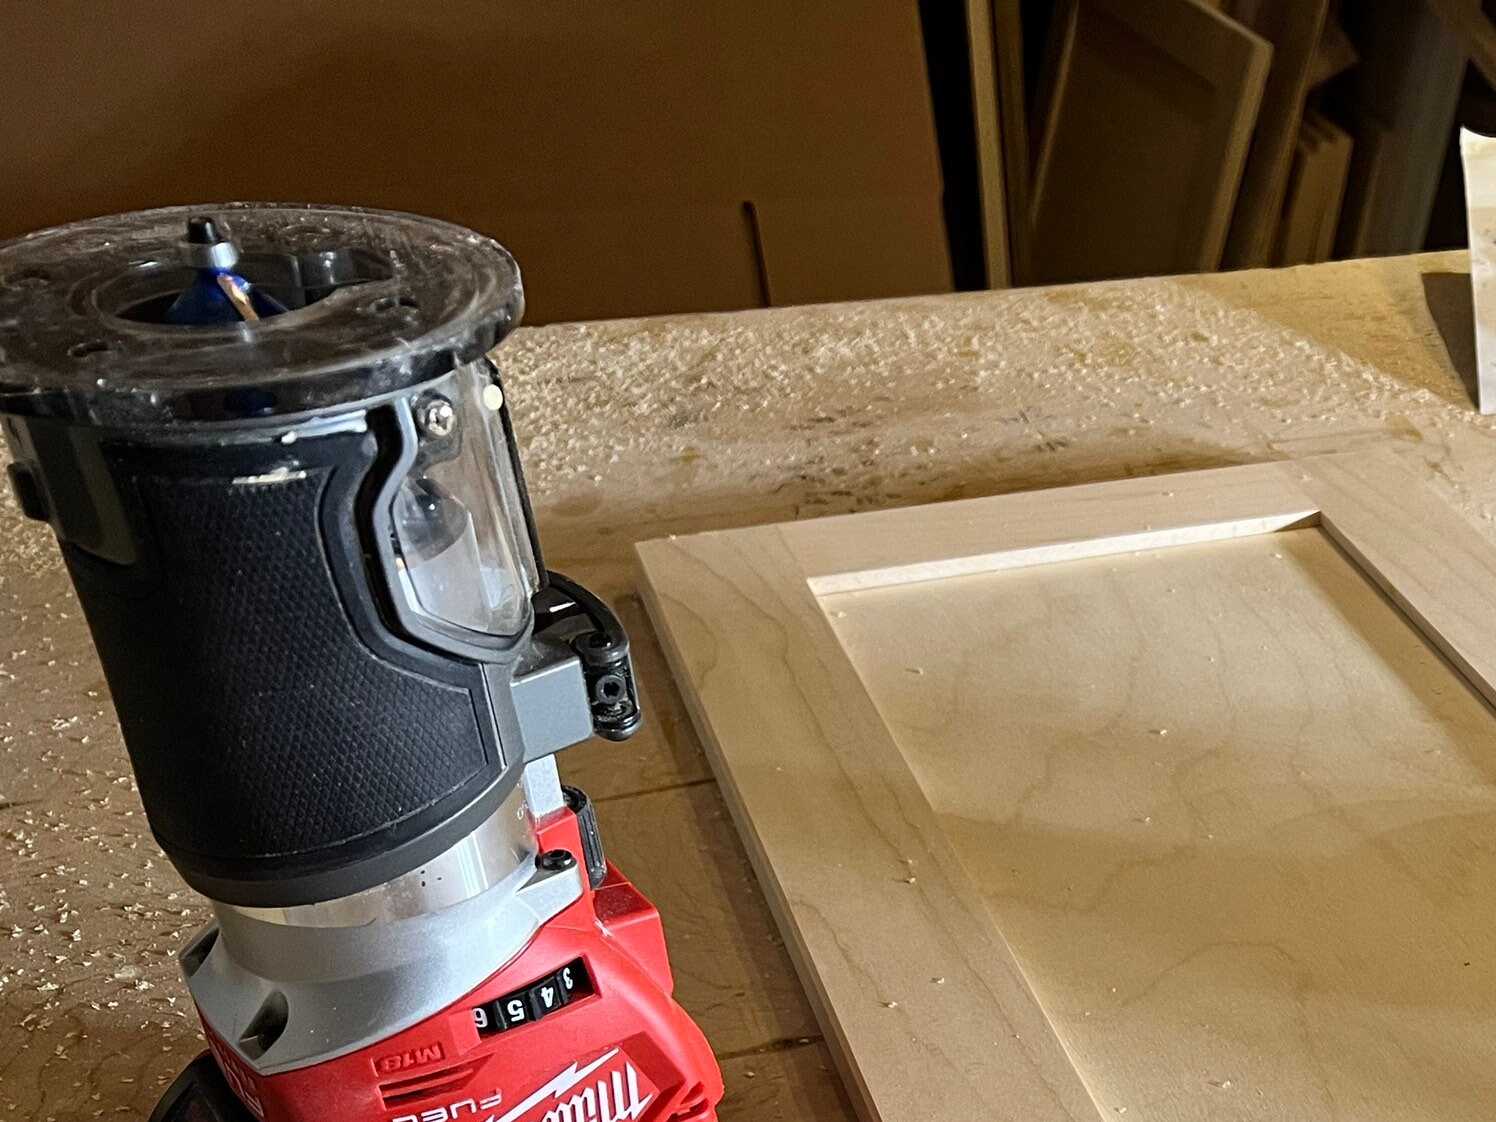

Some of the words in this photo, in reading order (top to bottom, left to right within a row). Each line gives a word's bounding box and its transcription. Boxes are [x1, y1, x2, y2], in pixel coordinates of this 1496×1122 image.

[563, 967, 573, 989] 3
[541, 987, 554, 1008] 4
[507, 1000, 525, 1022] 5
